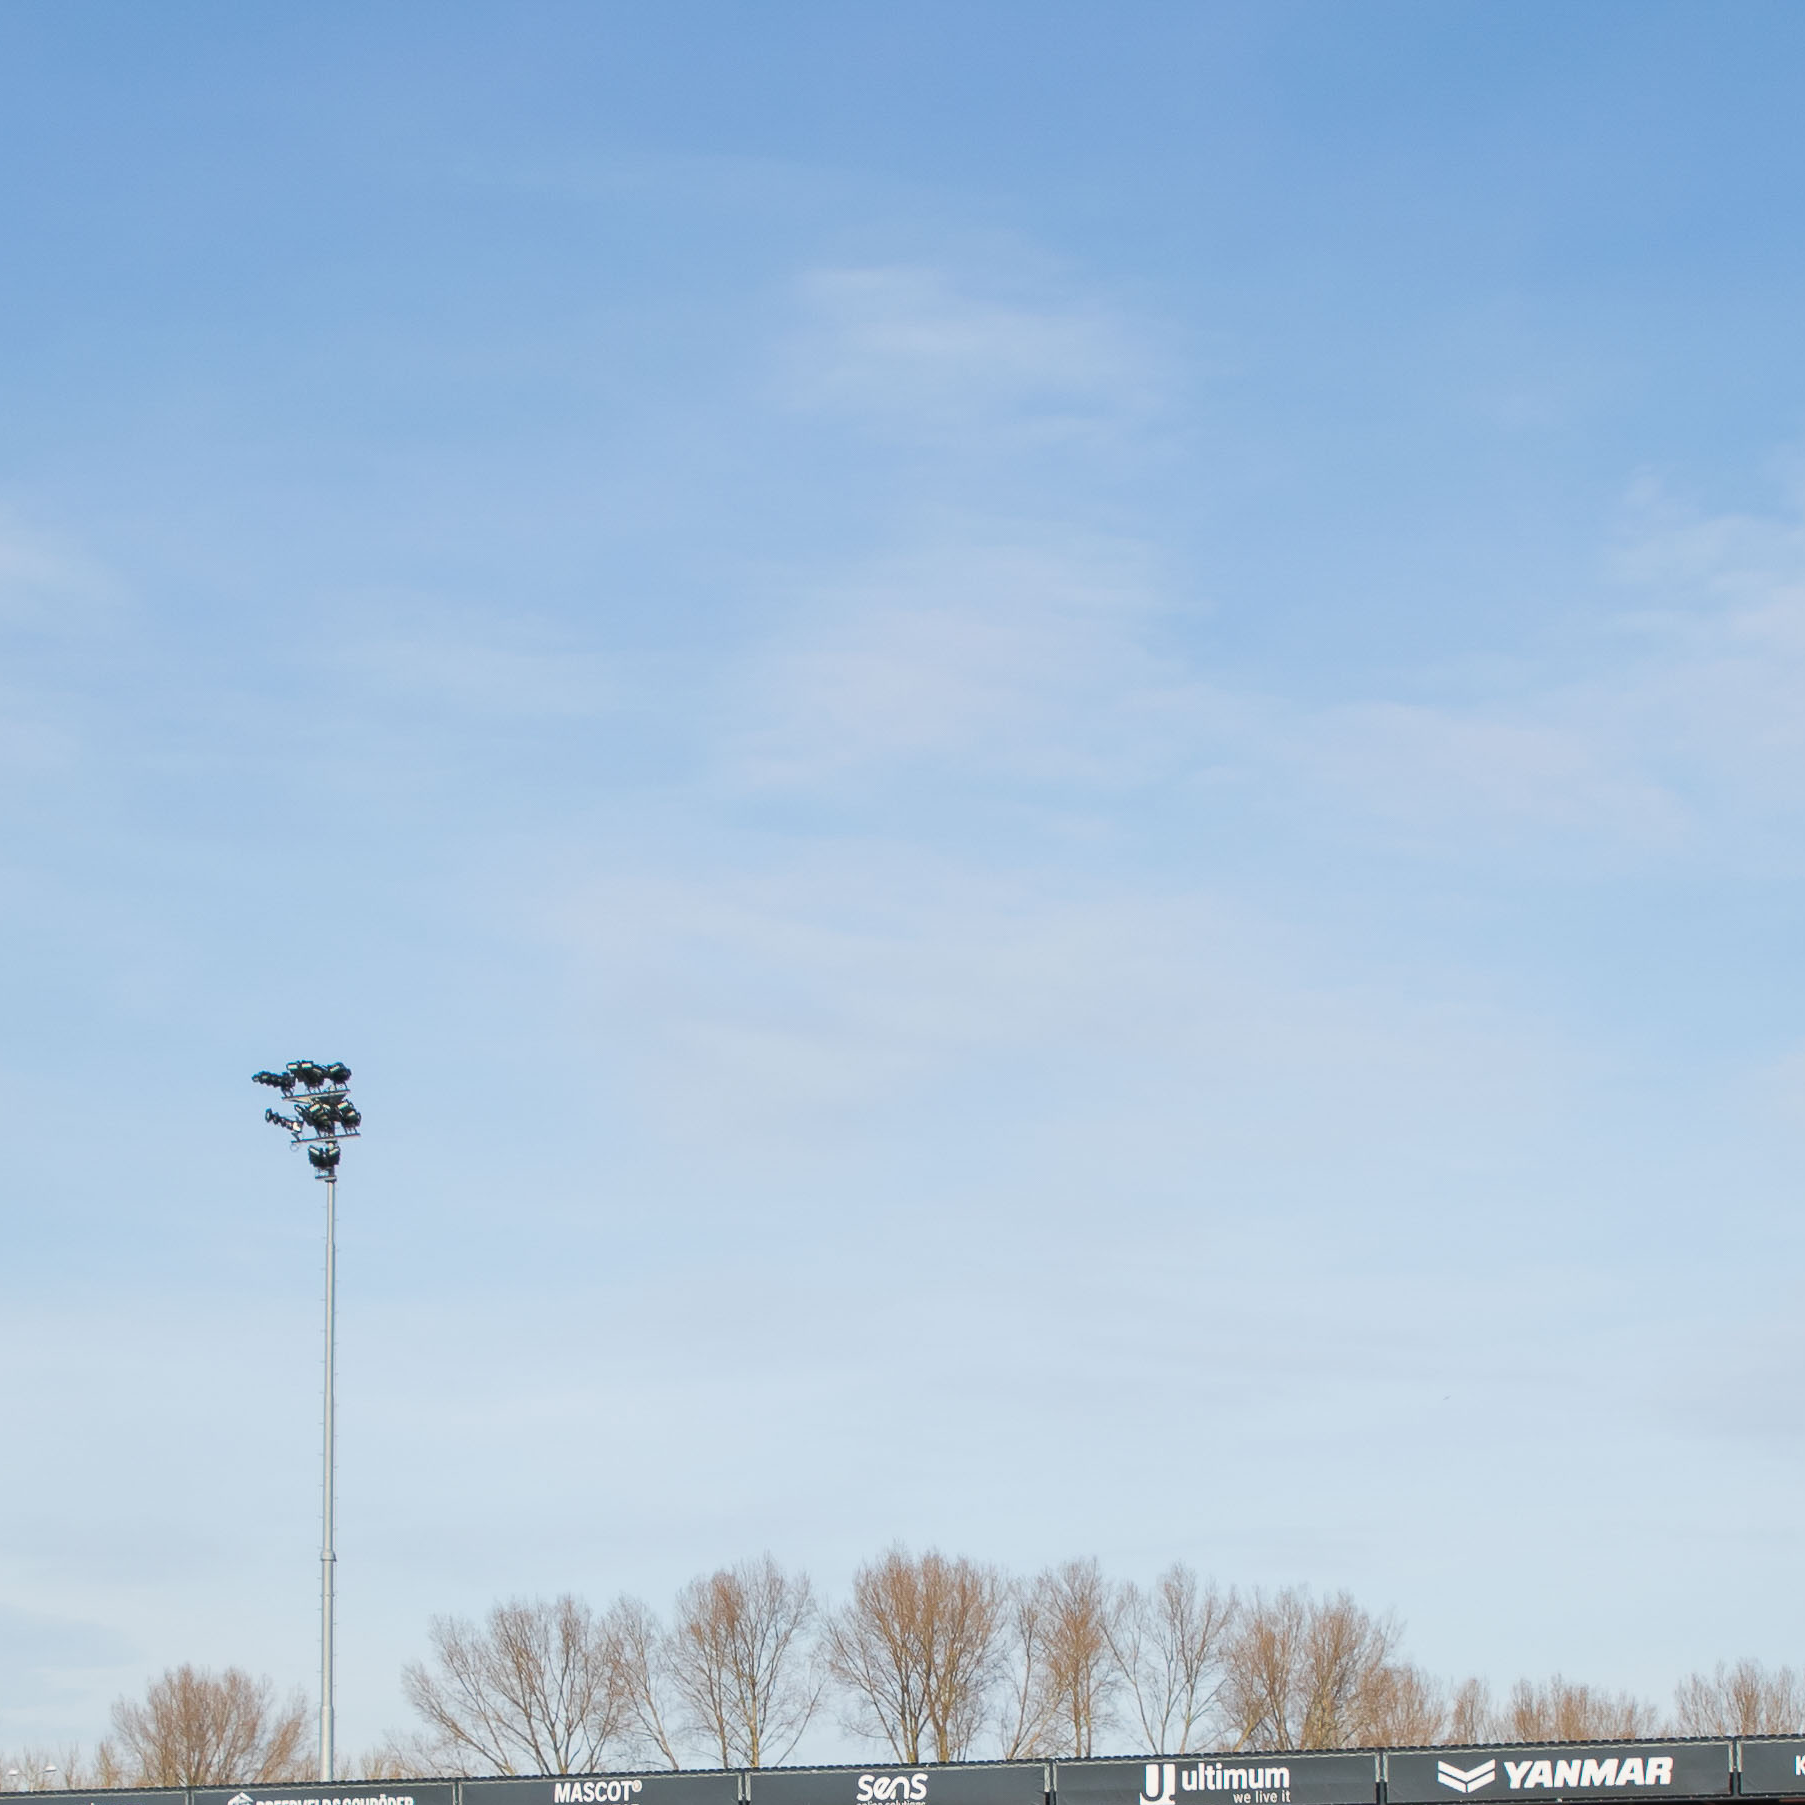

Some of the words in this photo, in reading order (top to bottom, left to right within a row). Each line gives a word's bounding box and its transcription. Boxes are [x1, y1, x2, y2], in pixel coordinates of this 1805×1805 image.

[1182, 1762, 1290, 1791] ultimum
[1503, 1757, 1674, 1789] YANMAR
[1233, 1793, 1251, 1804] we
[1255, 1790, 1278, 1803] live
[1281, 1790, 1291, 1803] it
